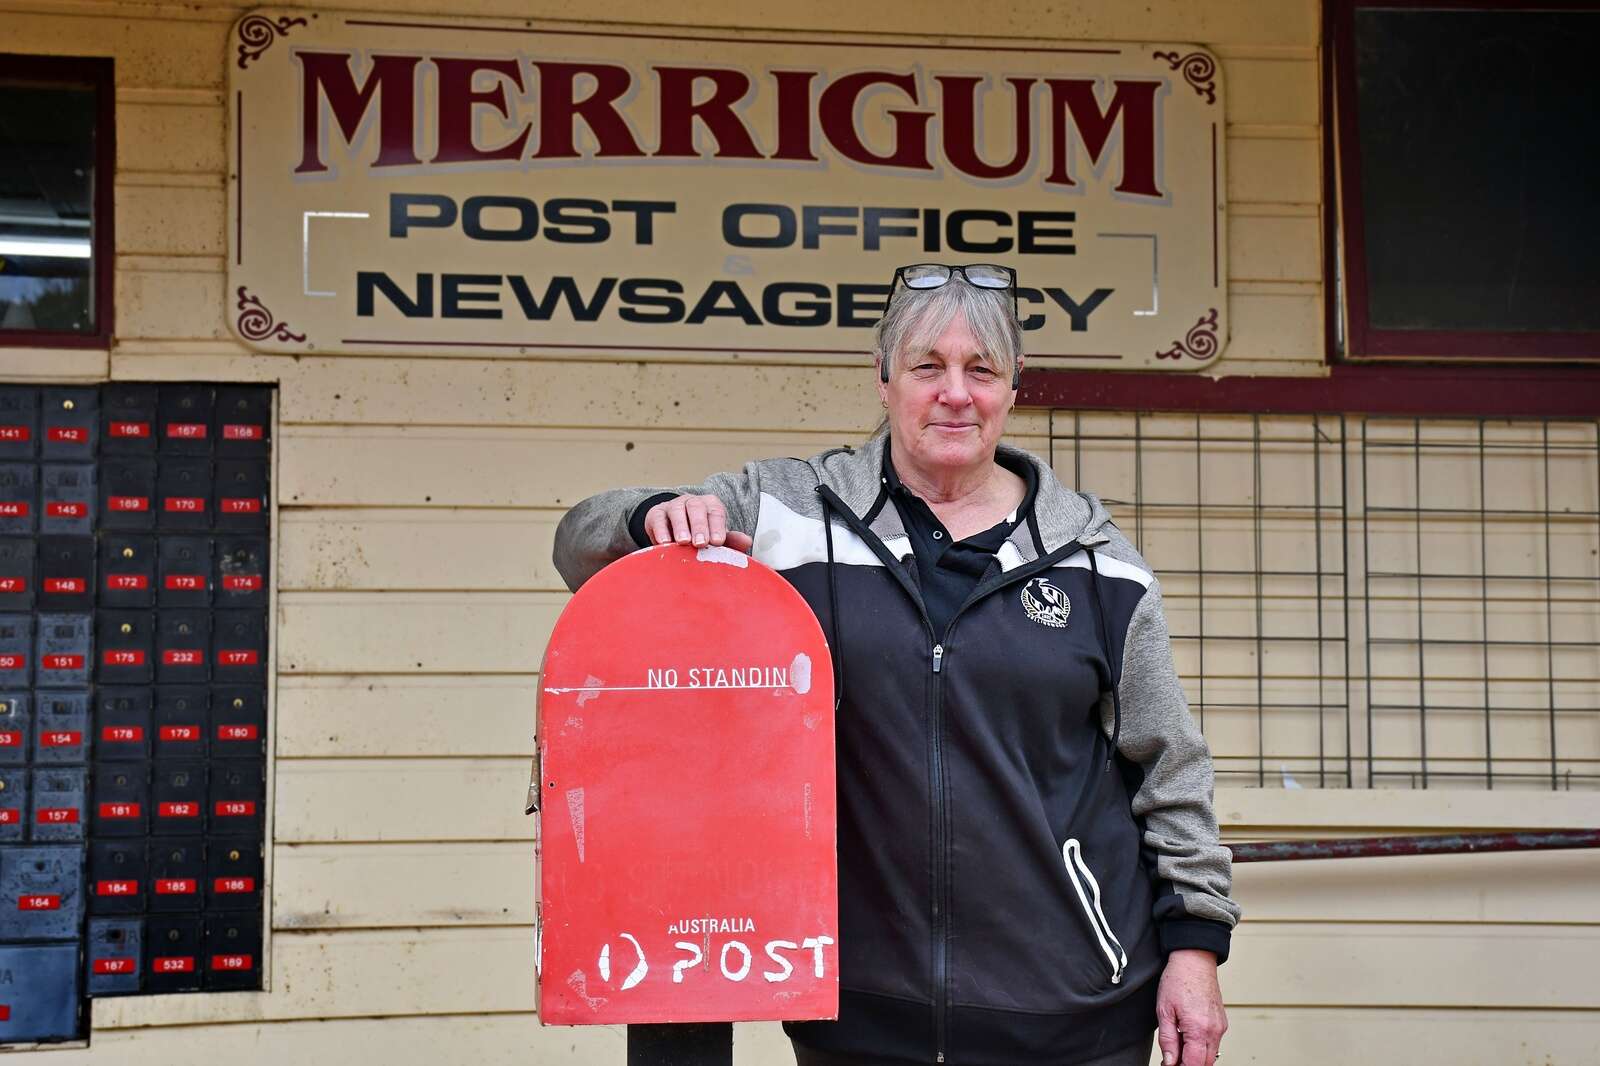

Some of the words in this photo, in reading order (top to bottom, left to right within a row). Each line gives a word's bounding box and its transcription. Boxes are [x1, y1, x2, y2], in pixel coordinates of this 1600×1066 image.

[294, 51, 1163, 197] MERRIGUM
[389, 192, 677, 246] POST
[721, 203, 1077, 256] OFFICE
[356, 271, 1116, 333] NEWSAGECY
[0, 429, 20, 438] 141
[58, 430, 78, 440] 142
[177, 425, 198, 436] 167
[57, 505, 77, 515] 145
[175, 499, 196, 510] 170
[232, 500, 251, 510] 171
[0, 580, 15, 589] 47
[55, 580, 76, 591] 148
[117, 577, 138, 587] 172
[175, 577, 196, 588] 173
[233, 577, 253, 587] 174
[0, 656, 15, 667] 50
[53, 656, 73, 667] 151
[115, 652, 135, 663] 175
[172, 652, 194, 663] 232
[228, 652, 249, 662] 177
[648, 668, 678, 688] NO
[688, 667, 788, 688] STANDIN
[113, 729, 134, 739] 178
[170, 728, 191, 738] 179
[228, 727, 248, 738] 180
[0, 734, 12, 744] 53
[51, 733, 71, 744] 154
[111, 805, 130, 816] 181
[169, 804, 190, 815] 182
[226, 803, 246, 814] 183
[48, 810, 69, 821] 157
[107, 883, 128, 893] 184
[29, 897, 50, 908] 164
[668, 918, 756, 935] AUSTRALIA
[104, 960, 125, 971] 187
[163, 959, 185, 970] 532
[223, 957, 243, 968] 189
